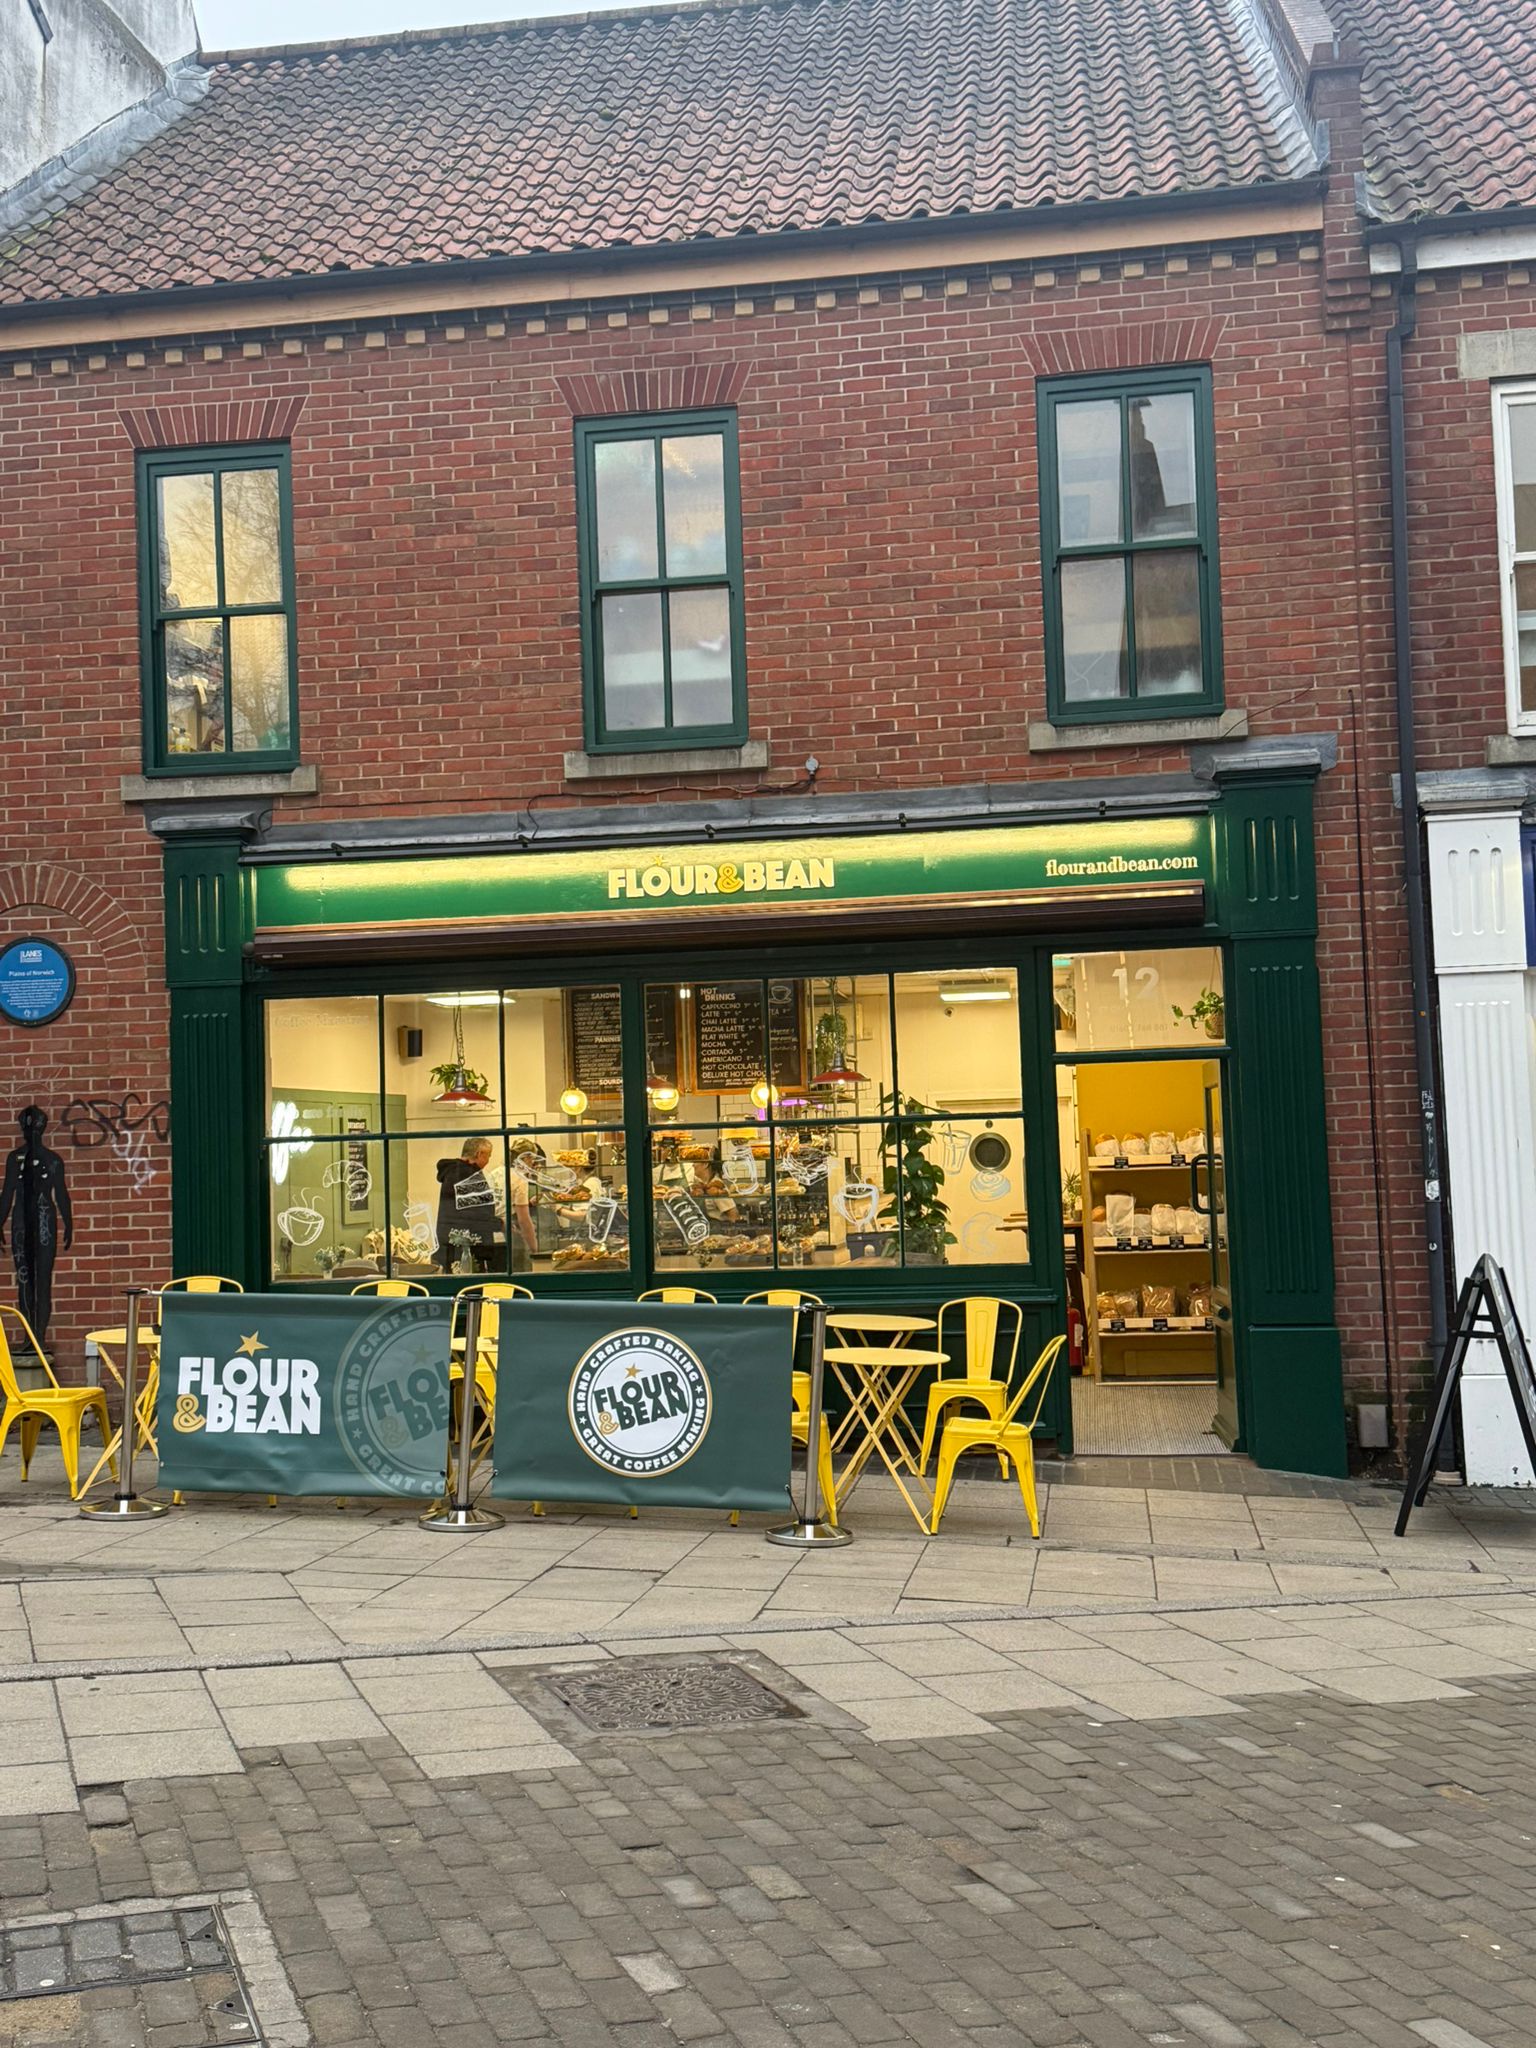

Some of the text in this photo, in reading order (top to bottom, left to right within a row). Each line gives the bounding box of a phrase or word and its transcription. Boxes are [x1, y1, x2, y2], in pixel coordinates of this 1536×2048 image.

[608, 858, 835, 898] FLOUR&BEAN
[1045, 856, 1199, 877] flourandbean.com
[700, 987, 718, 995] HOT
[705, 993, 736, 1001] DRINKS
[1112, 966, 1160, 1000] 12
[701, 1010, 720, 1018] LATTE
[701, 1048, 734, 1056] CORTADO
[717, 1062, 760, 1070] CHOCOLATE
[177, 1356, 320, 1400] FLOUR
[346, 1363, 363, 1422] HAND
[359, 1304, 442, 1358] CRAFTED
[576, 1335, 700, 1412] HAND CRAFTED BAKING
[593, 1370, 684, 1413] FLOUR
[582, 1397, 706, 1471] GREAT COFFEE MAKING
[359, 1444, 416, 1490] GREAT
